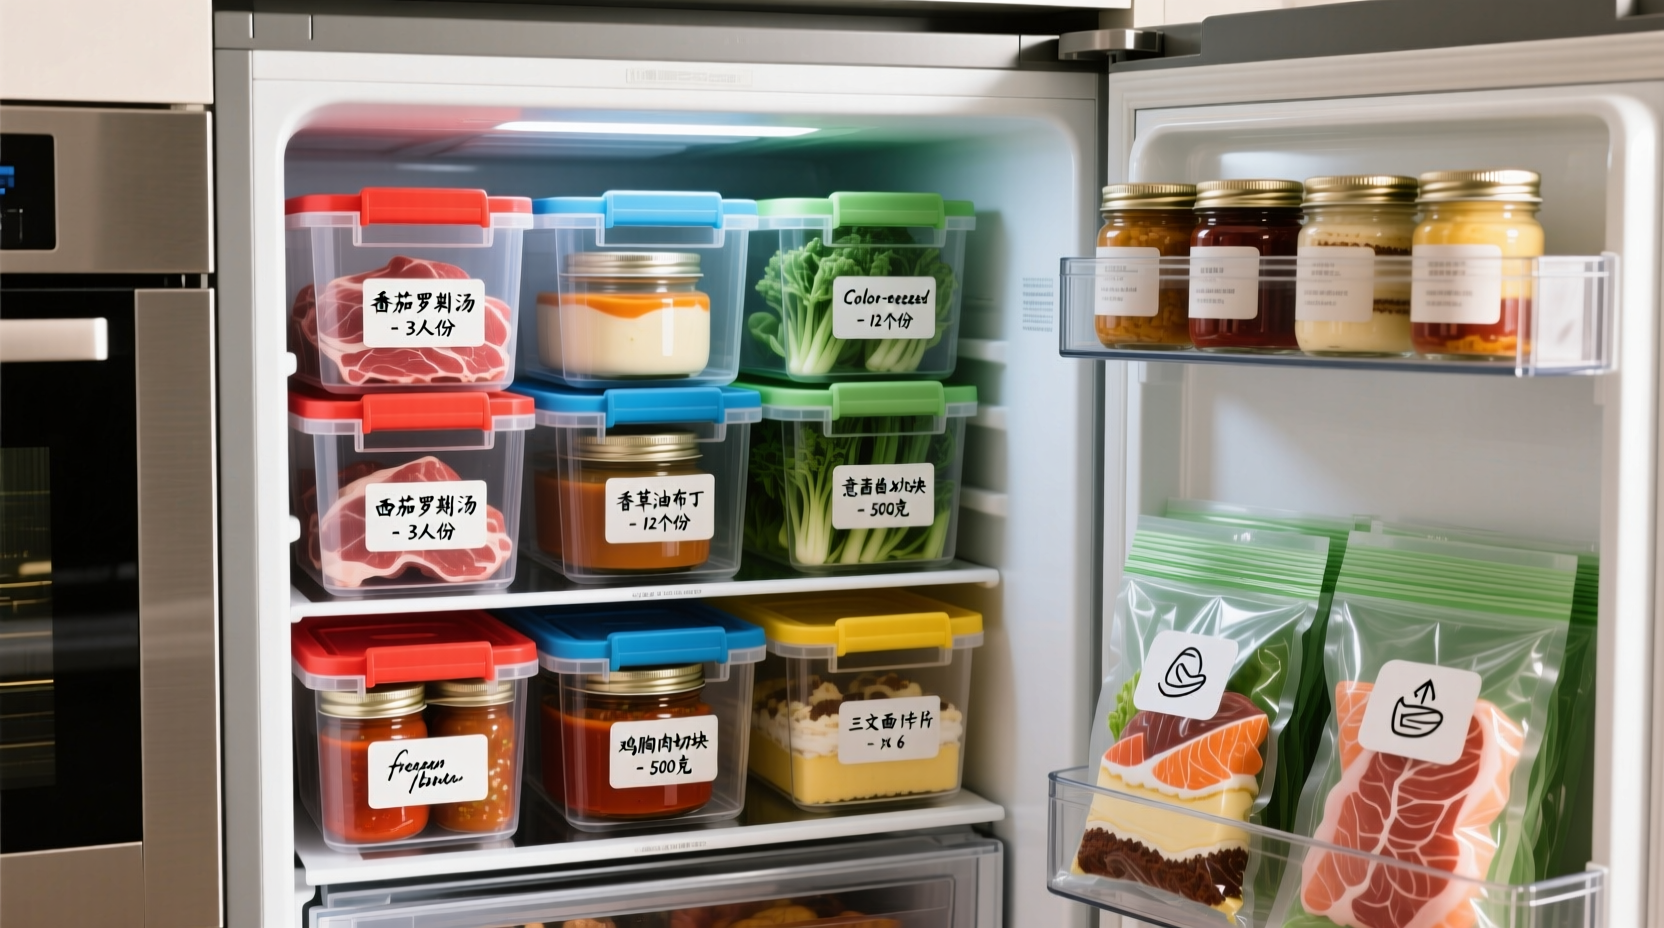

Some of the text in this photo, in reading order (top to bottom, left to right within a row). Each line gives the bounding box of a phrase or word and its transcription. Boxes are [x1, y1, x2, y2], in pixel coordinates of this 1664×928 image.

[406, 318, 456, 338] 3人份
[870, 312, 914, 331] 12个份
[616, 488, 705, 512] 香草油布丁
[869, 498, 910, 518] 500克
[408, 521, 456, 541] 3人份
[643, 513, 691, 532] 12个份
[618, 730, 709, 756] 鸡胸肉切块
[897, 735, 905, 749] 6
[649, 755, 693, 776] 500克
